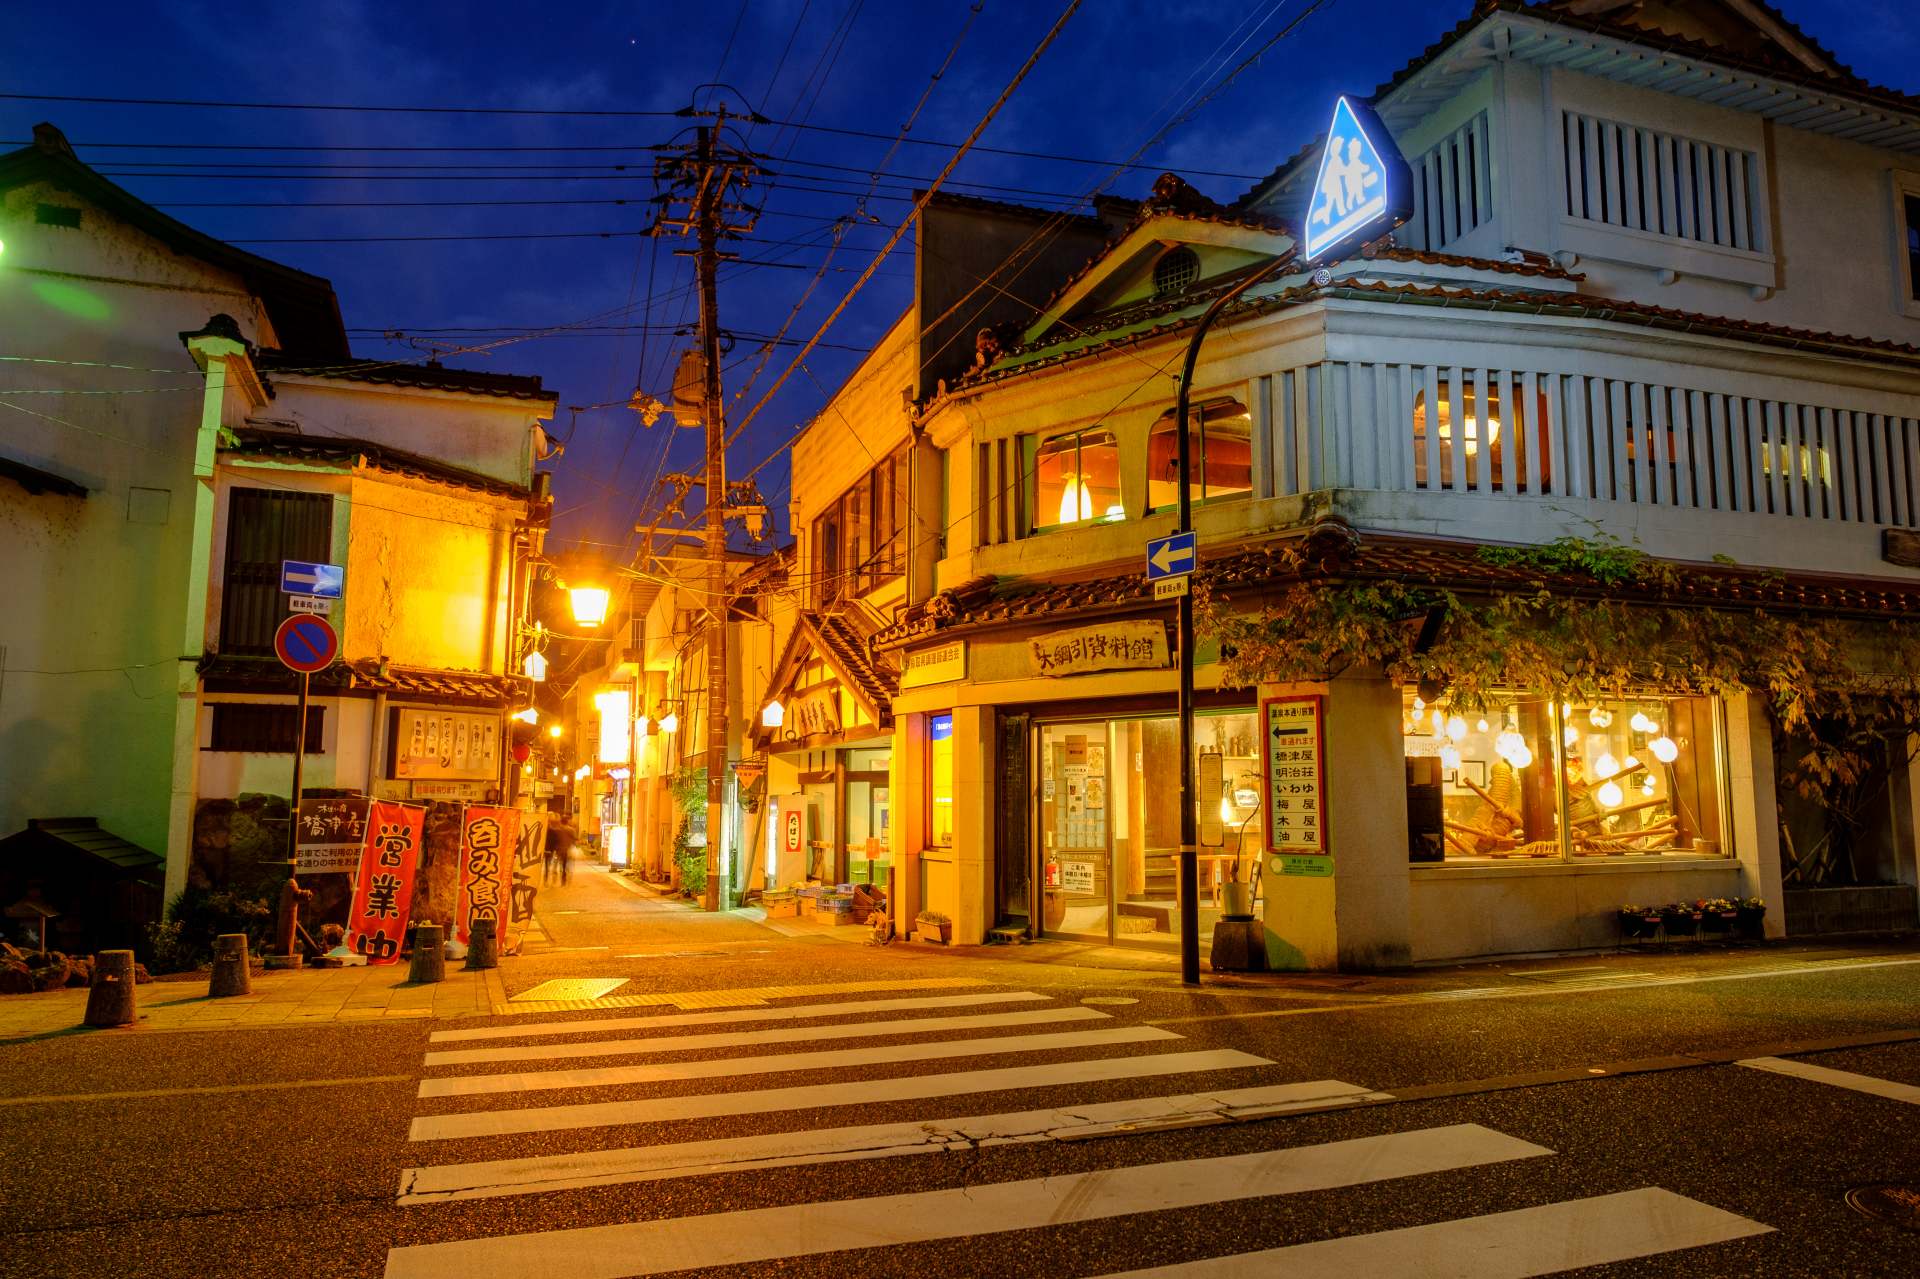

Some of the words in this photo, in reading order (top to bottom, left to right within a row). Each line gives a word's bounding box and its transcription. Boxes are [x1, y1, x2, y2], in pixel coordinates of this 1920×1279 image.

[1039, 634, 1153, 670] 大綱引資料館
[1275, 750, 1314, 762] 橋津屋
[1275, 767, 1315, 778] 明治荘
[1276, 783, 1315, 794] いわゆ
[1277, 816, 1316, 827] 木屋
[356, 824, 413, 959] 営業中
